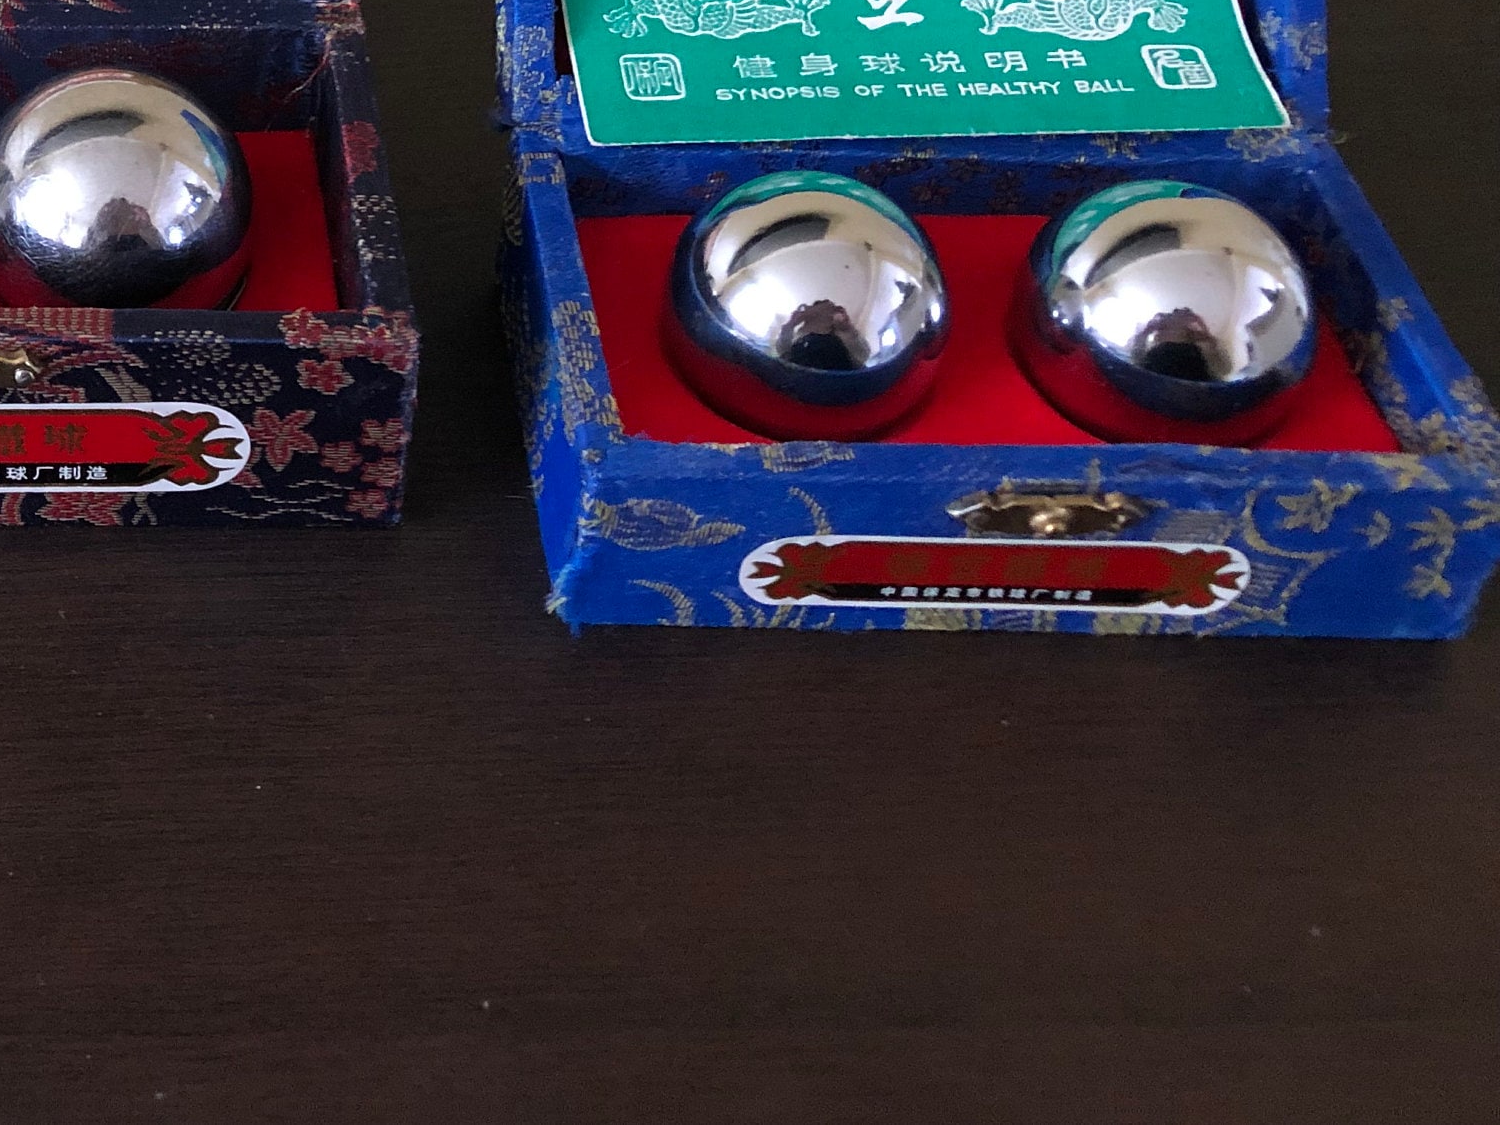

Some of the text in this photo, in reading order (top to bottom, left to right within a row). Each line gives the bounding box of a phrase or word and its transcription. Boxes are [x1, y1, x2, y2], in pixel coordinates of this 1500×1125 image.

[733, 49, 1087, 78] 健身球说明书
[716, 79, 1134, 101] SYNOPSIS OF THE HEALTHY BALL
